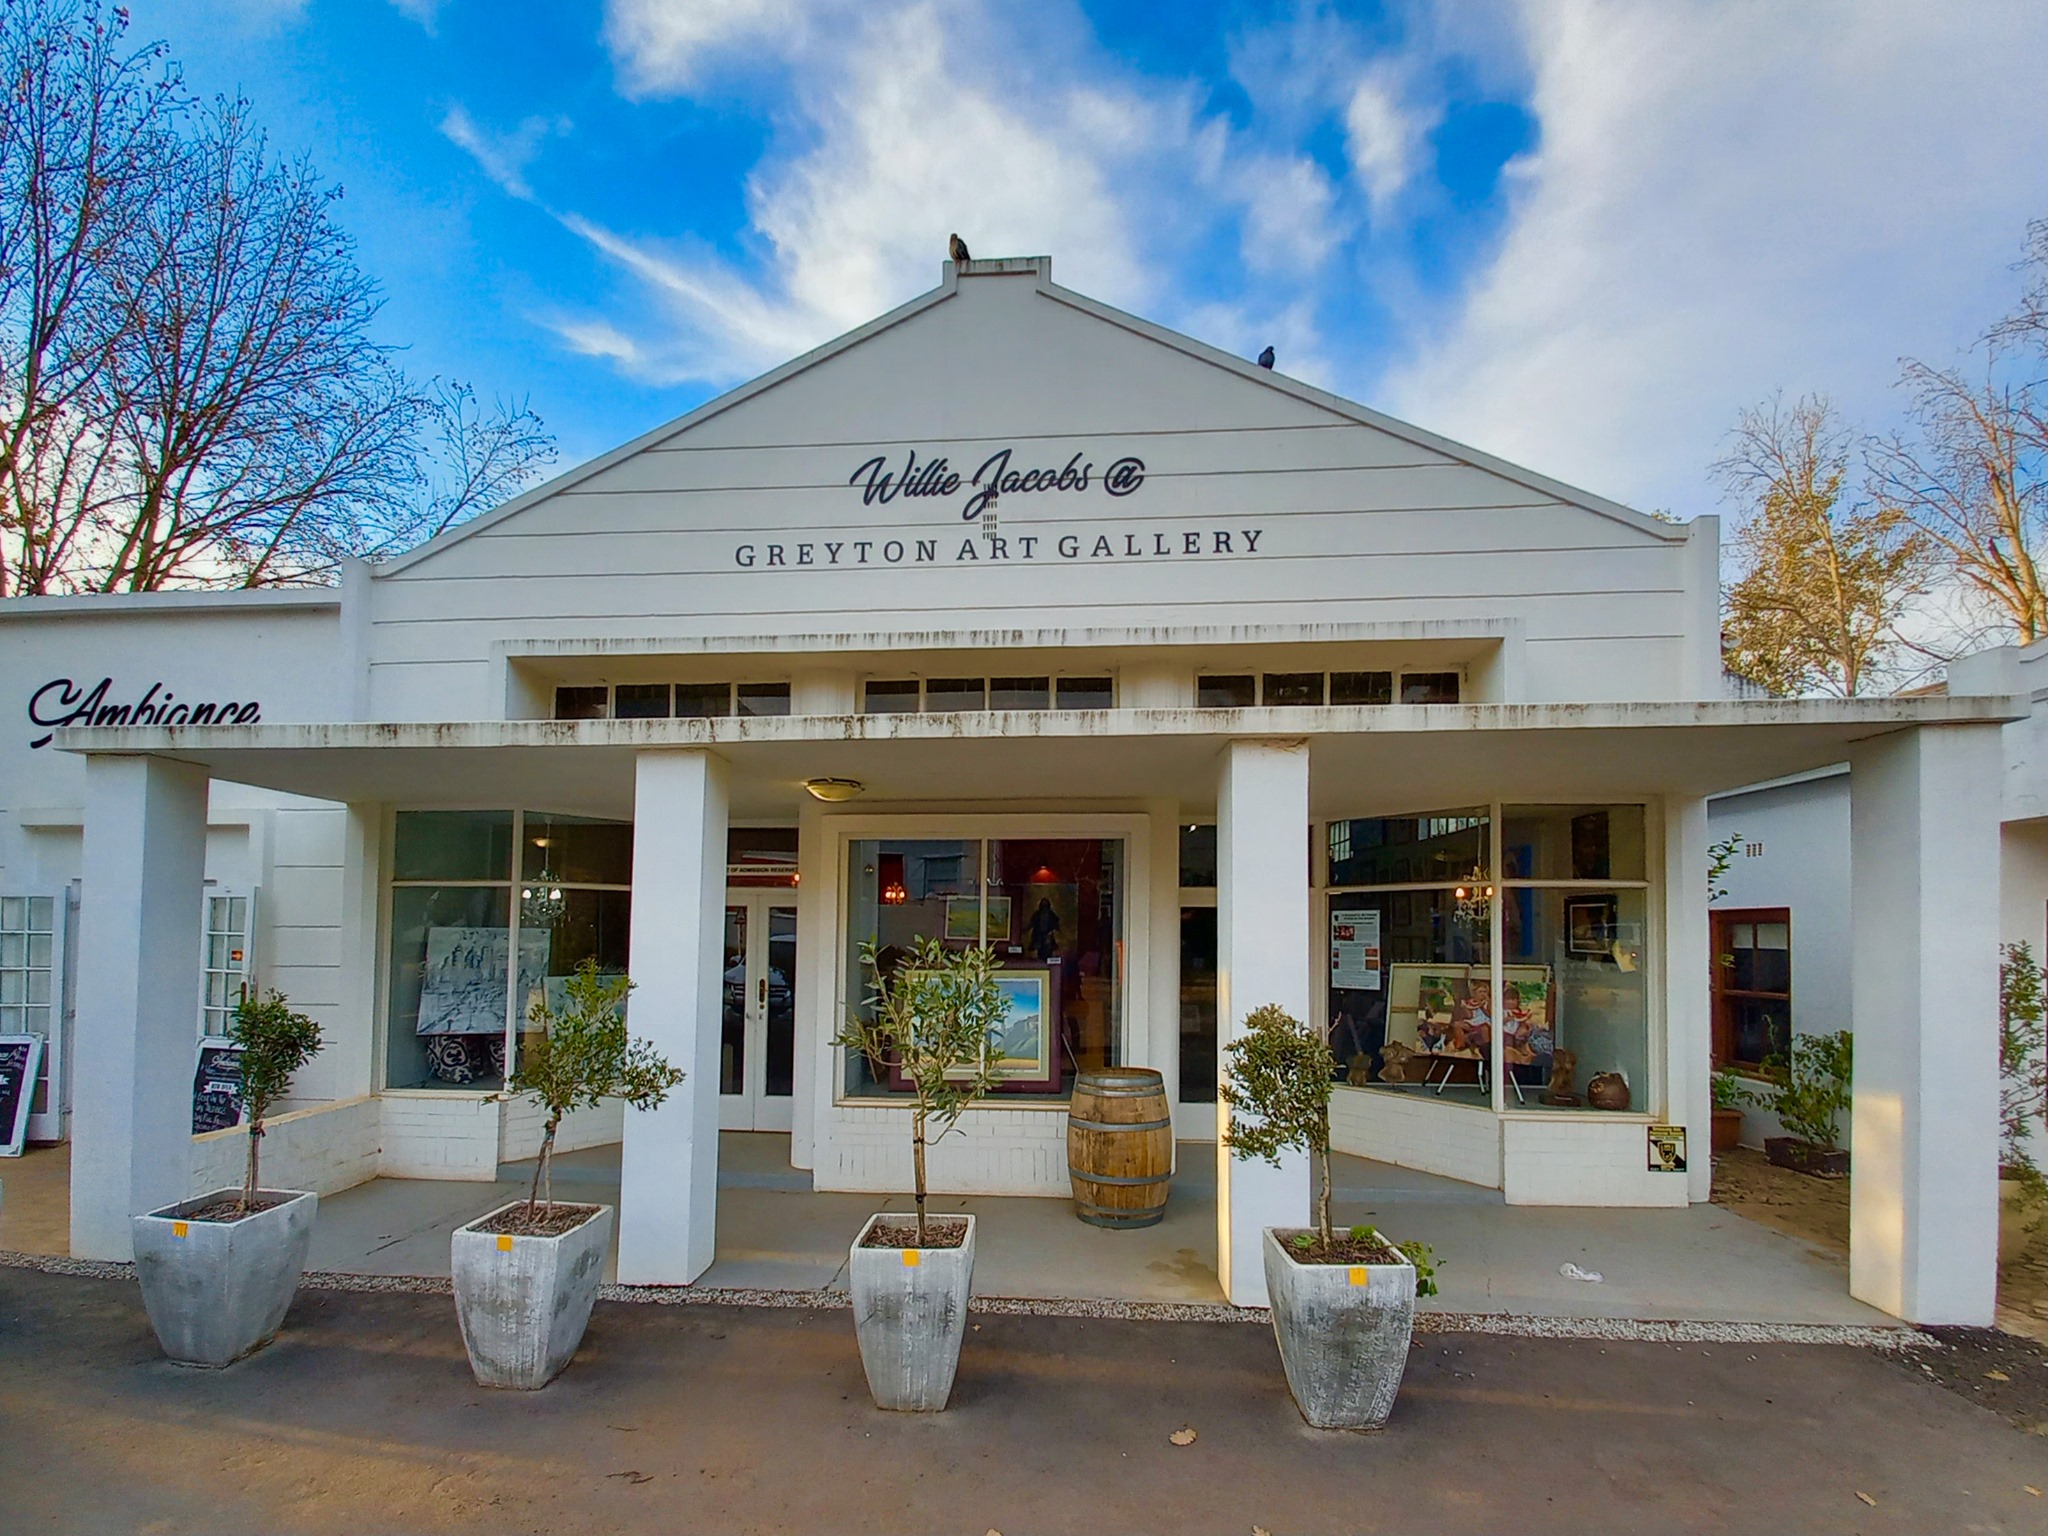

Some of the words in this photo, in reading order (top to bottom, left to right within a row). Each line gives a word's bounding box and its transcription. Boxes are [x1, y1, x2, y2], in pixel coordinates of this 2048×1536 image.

[849, 450, 961, 506] Willie
[962, 449, 1091, 521] Jacobs
[1104, 457, 1145, 496] @
[735, 539, 937, 568] GREYTON
[956, 536, 1039, 561] ART
[1057, 529, 1264, 558] GALLERY
